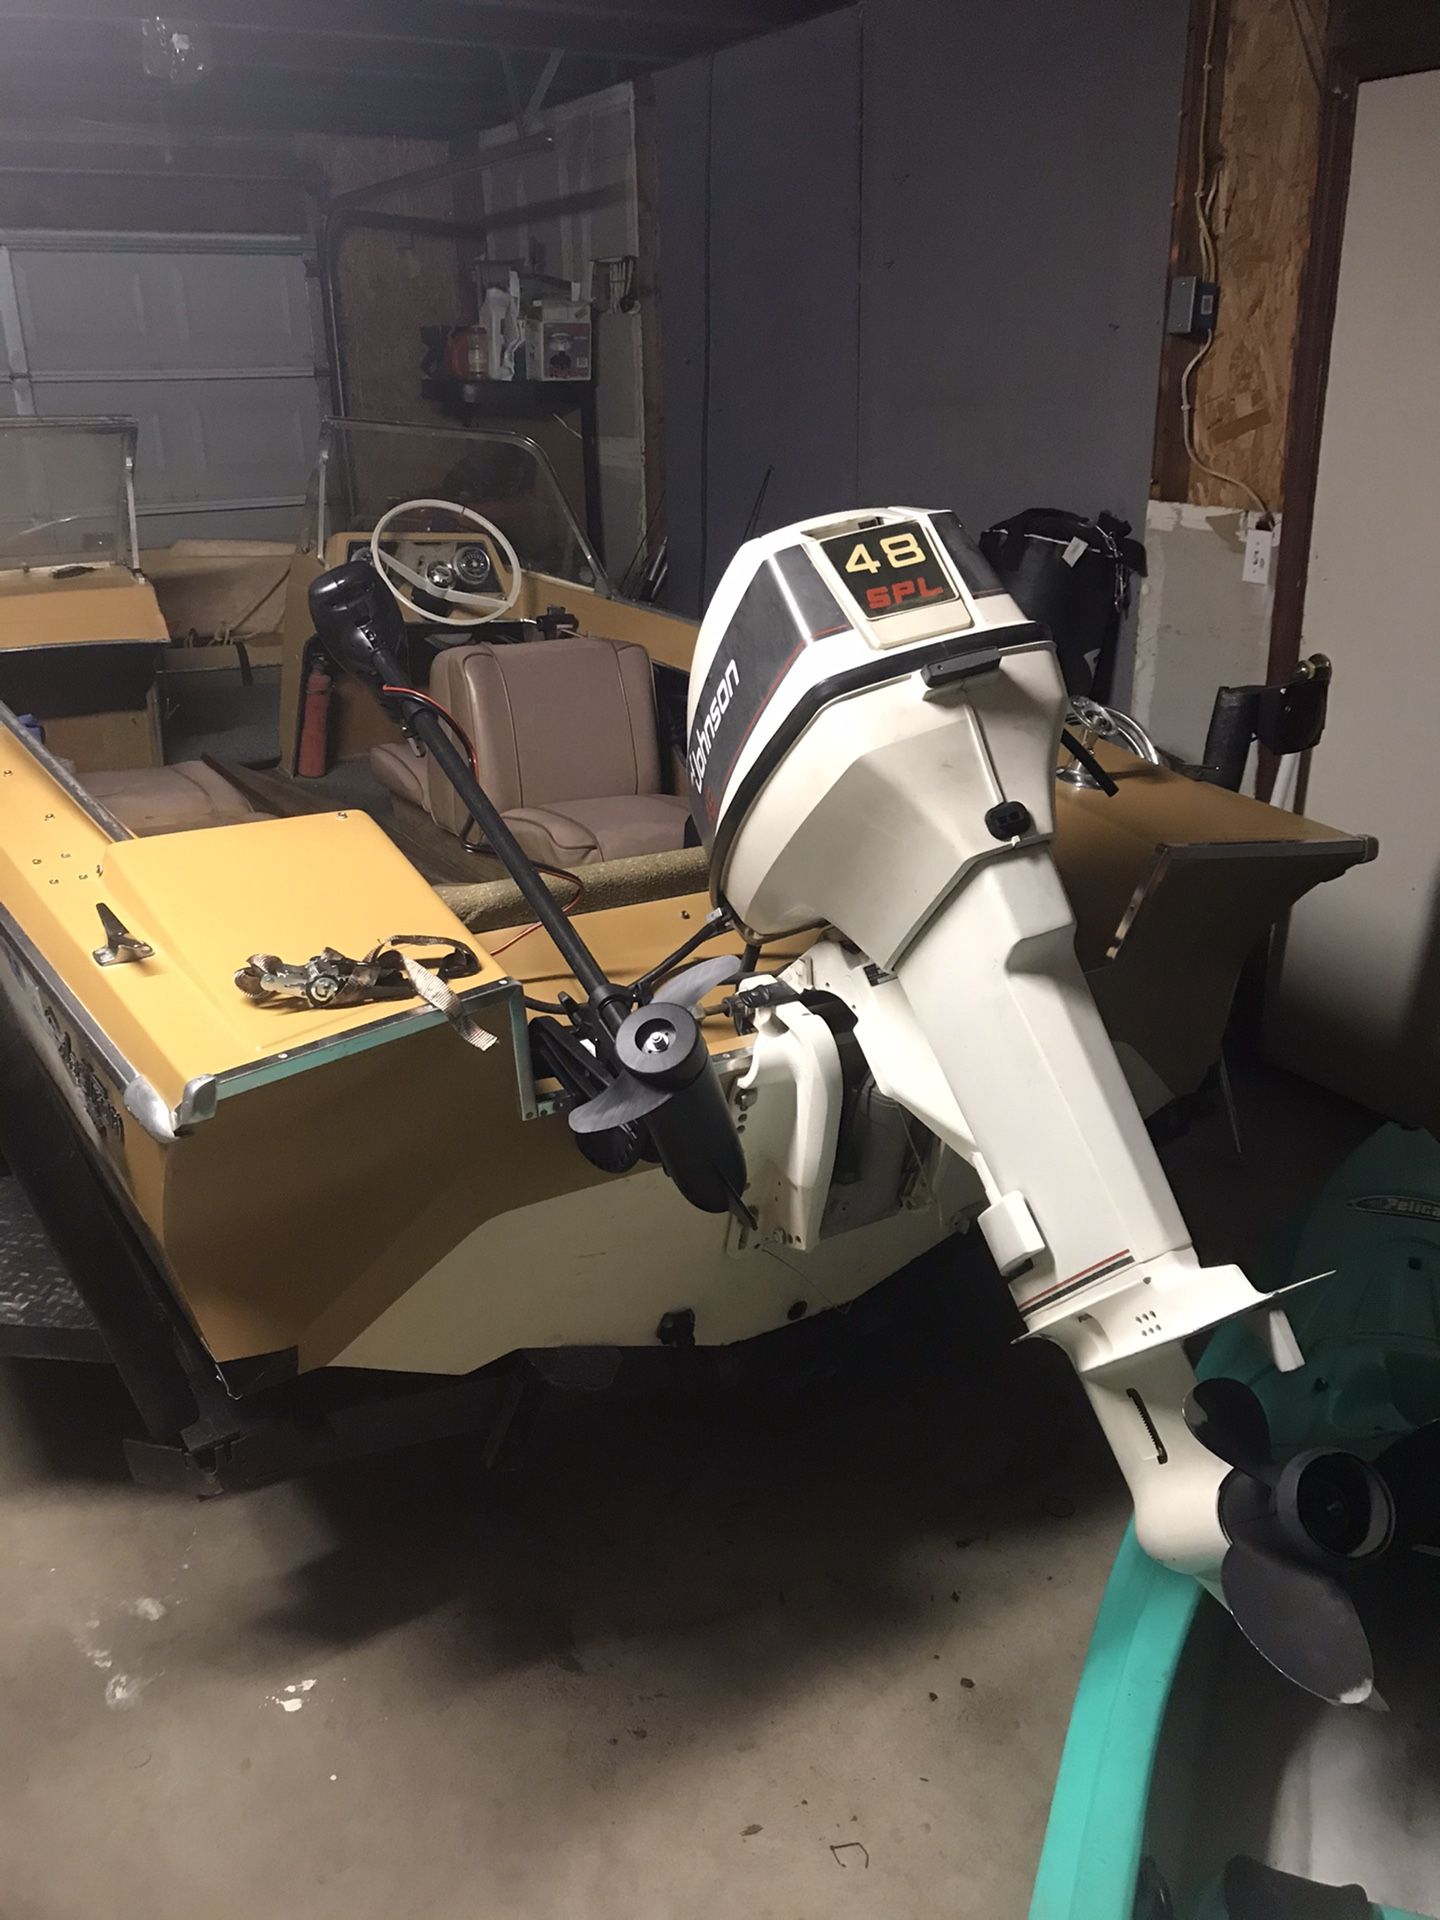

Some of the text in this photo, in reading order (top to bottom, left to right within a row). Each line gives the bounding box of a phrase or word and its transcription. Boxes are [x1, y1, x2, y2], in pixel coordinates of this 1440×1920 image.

[845, 533, 926, 574] 48
[866, 577, 944, 609] SPL
[688, 659, 740, 794] Johnson
